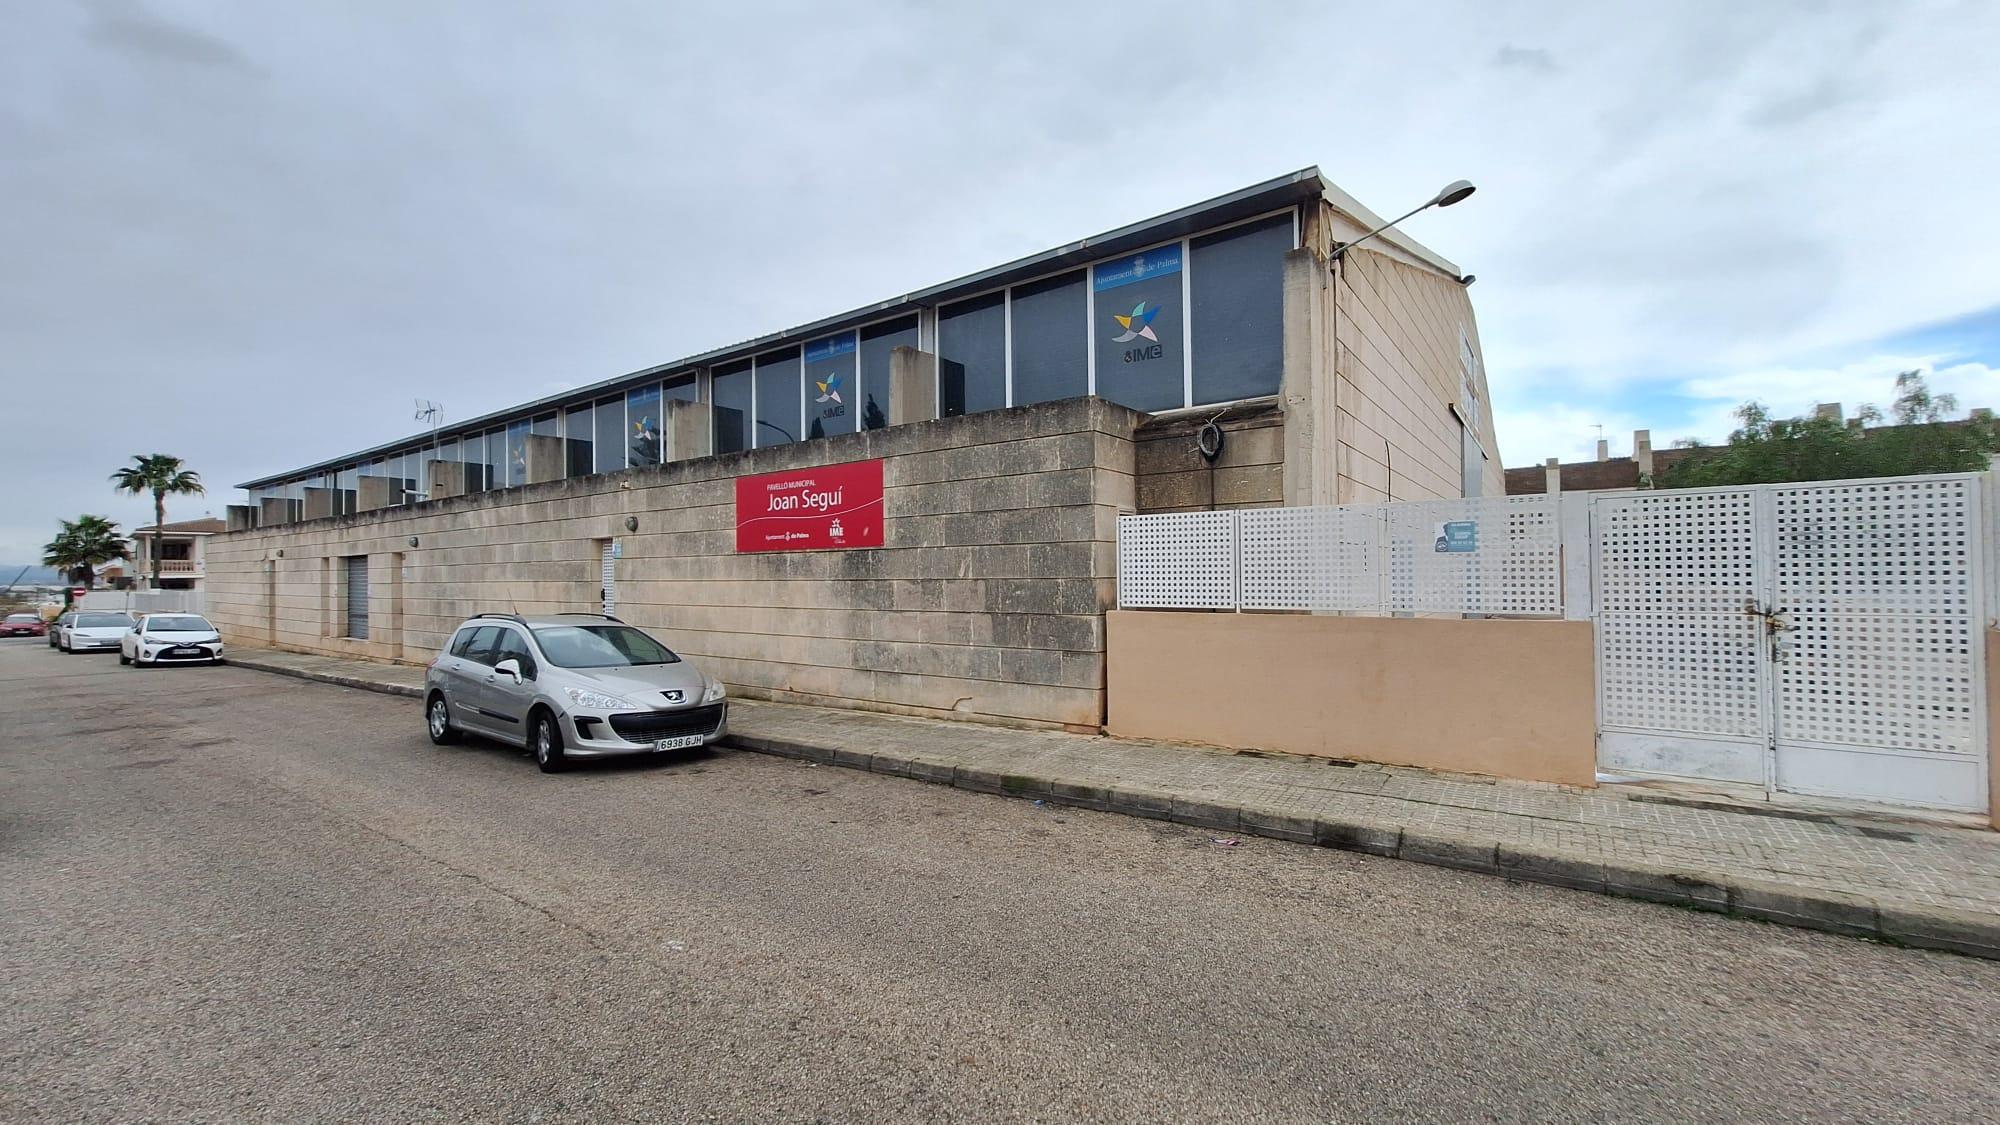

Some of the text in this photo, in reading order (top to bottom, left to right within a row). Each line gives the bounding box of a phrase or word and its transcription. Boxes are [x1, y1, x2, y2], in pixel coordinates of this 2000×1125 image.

[789, 480, 816, 489] MUNICIPAL
[767, 486, 842, 512] Joan Seguí
[830, 527, 844, 537] IME
[661, 735, 702, 750] 6938 GJH
